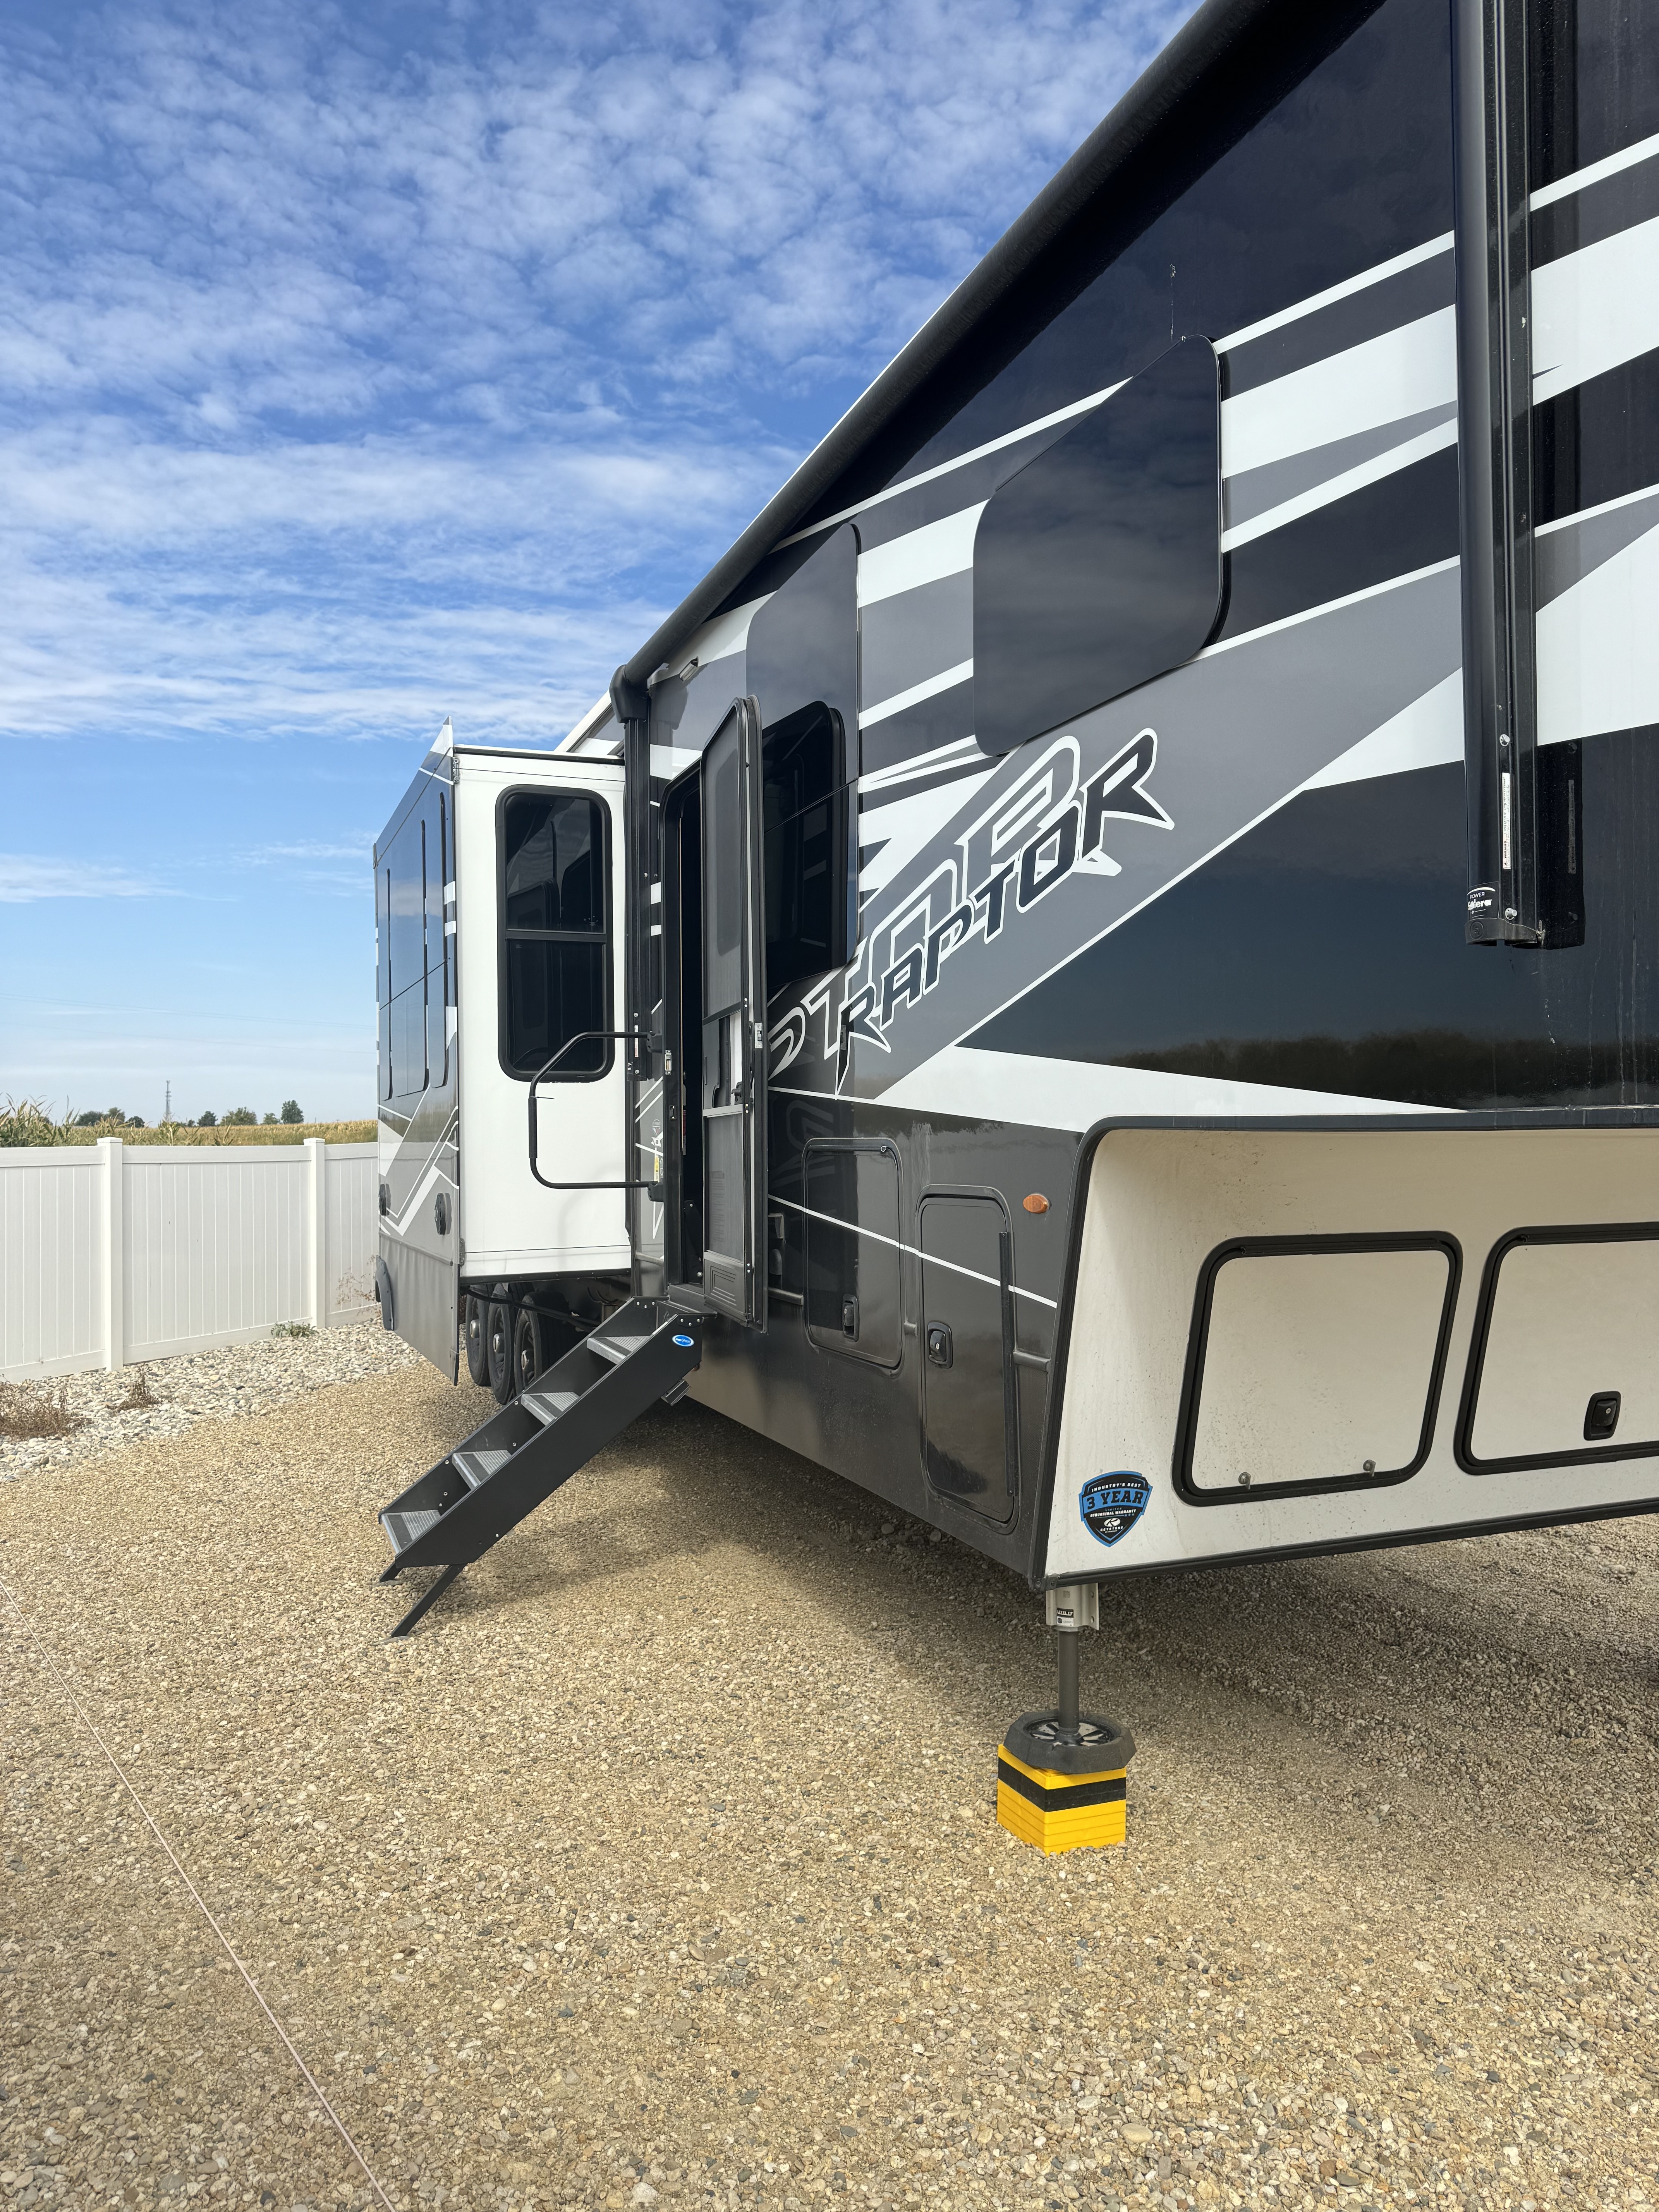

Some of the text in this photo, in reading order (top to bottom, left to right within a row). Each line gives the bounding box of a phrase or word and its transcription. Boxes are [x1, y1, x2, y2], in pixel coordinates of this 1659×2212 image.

[835, 728, 1175, 1100] RAPTOR
[1092, 1483, 1125, 1492] INDUSTRY'S
[1087, 1490, 1144, 1510] 3 YEAR
